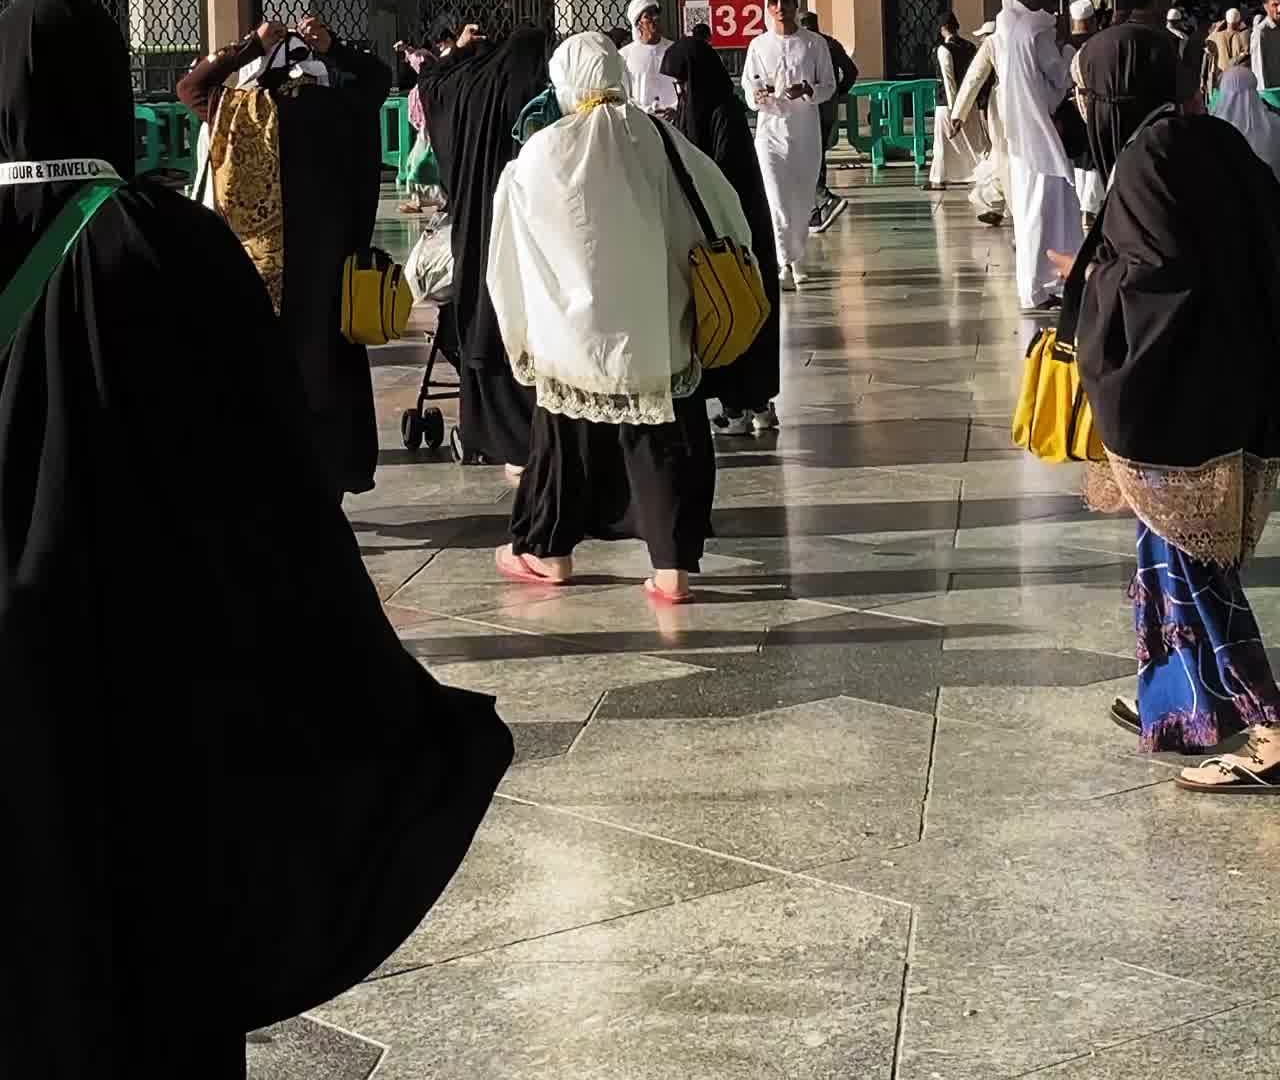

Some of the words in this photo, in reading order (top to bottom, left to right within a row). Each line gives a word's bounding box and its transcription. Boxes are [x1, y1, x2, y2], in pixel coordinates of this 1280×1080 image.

[715, 4, 764, 36] 32
[35, 164, 43, 178] &
[46, 162, 87, 177] TRAVEL
